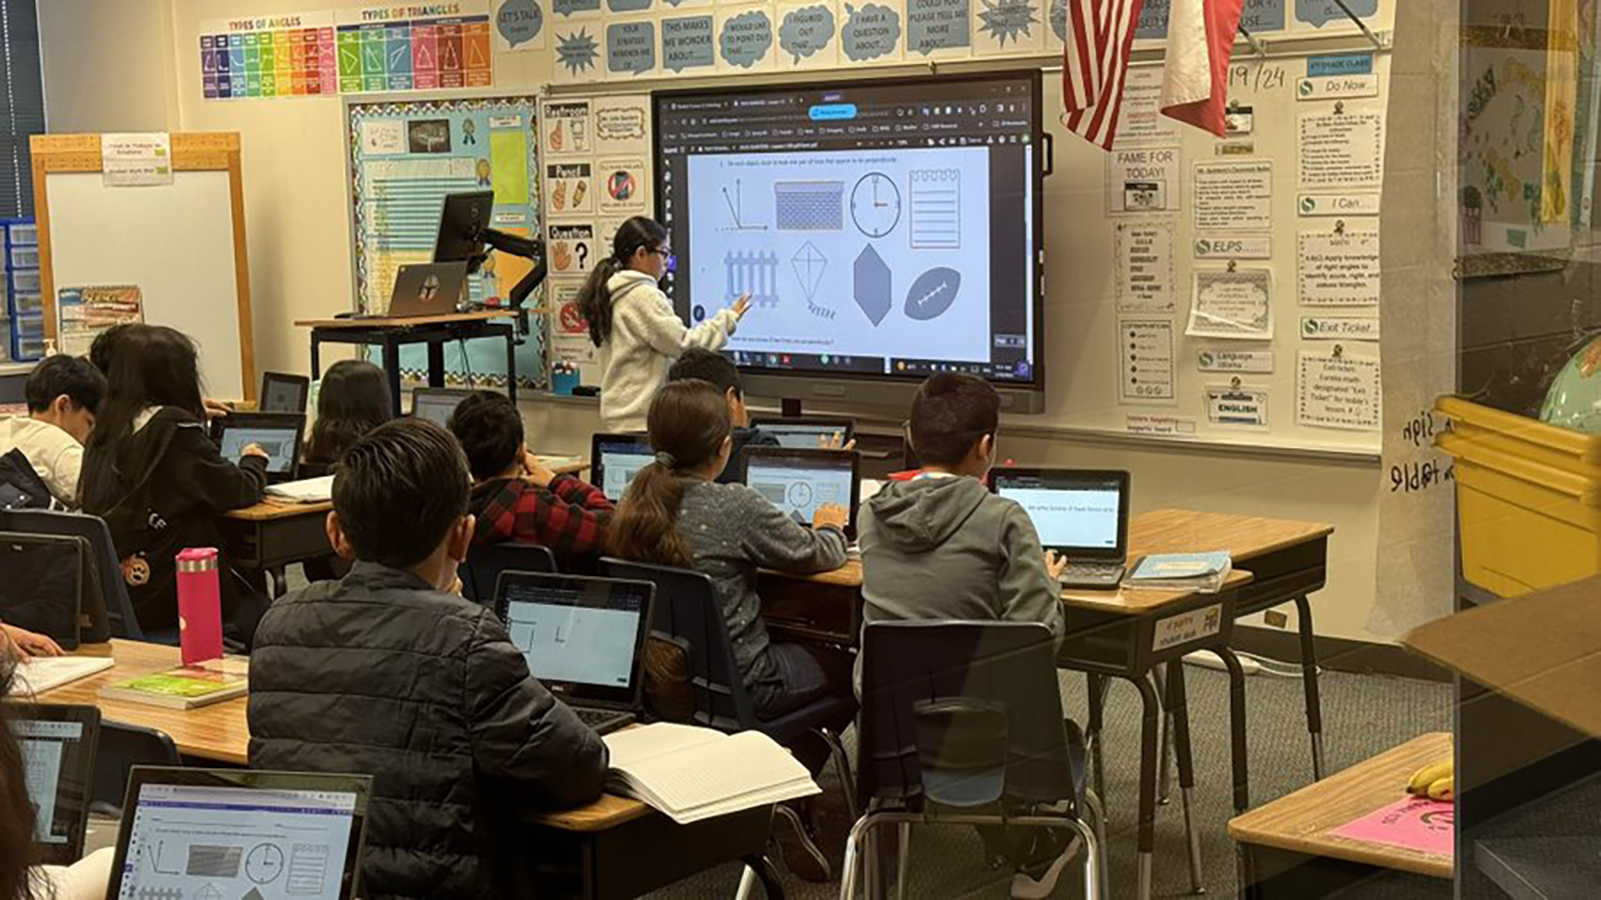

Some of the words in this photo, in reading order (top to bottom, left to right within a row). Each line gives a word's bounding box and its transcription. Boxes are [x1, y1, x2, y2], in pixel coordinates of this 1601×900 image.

[362, 9, 389, 20] TYPES
[391, 7, 404, 18] OF
[407, 4, 460, 17] TRIANGLES
[910, 12, 936, 22] PLEASE
[228, 20, 254, 31] TYPES
[256, 19, 266, 29] OF
[268, 16, 301, 28] ANGLES
[665, 22, 682, 32] THIS
[683, 20, 709, 30] MAKES
[735, 34, 756, 43] POINT
[757, 32, 769, 41] OUT
[798, 28, 813, 37] OUT
[853, 28, 890, 38] QUESTION
[664, 38, 675, 47] ME
[676, 34, 712, 46] WONDER
[1326, 81, 1341, 92] Do
[1118, 152, 1147, 164] FAME
[1150, 151, 1173, 163] FOR
[556, 165, 581, 177] Pencil
[1126, 167, 1164, 179] TODAY!
[551, 227, 590, 239] Question
[1319, 321, 1339, 333] Exit
[1218, 404, 1258, 413] ENGLISH
